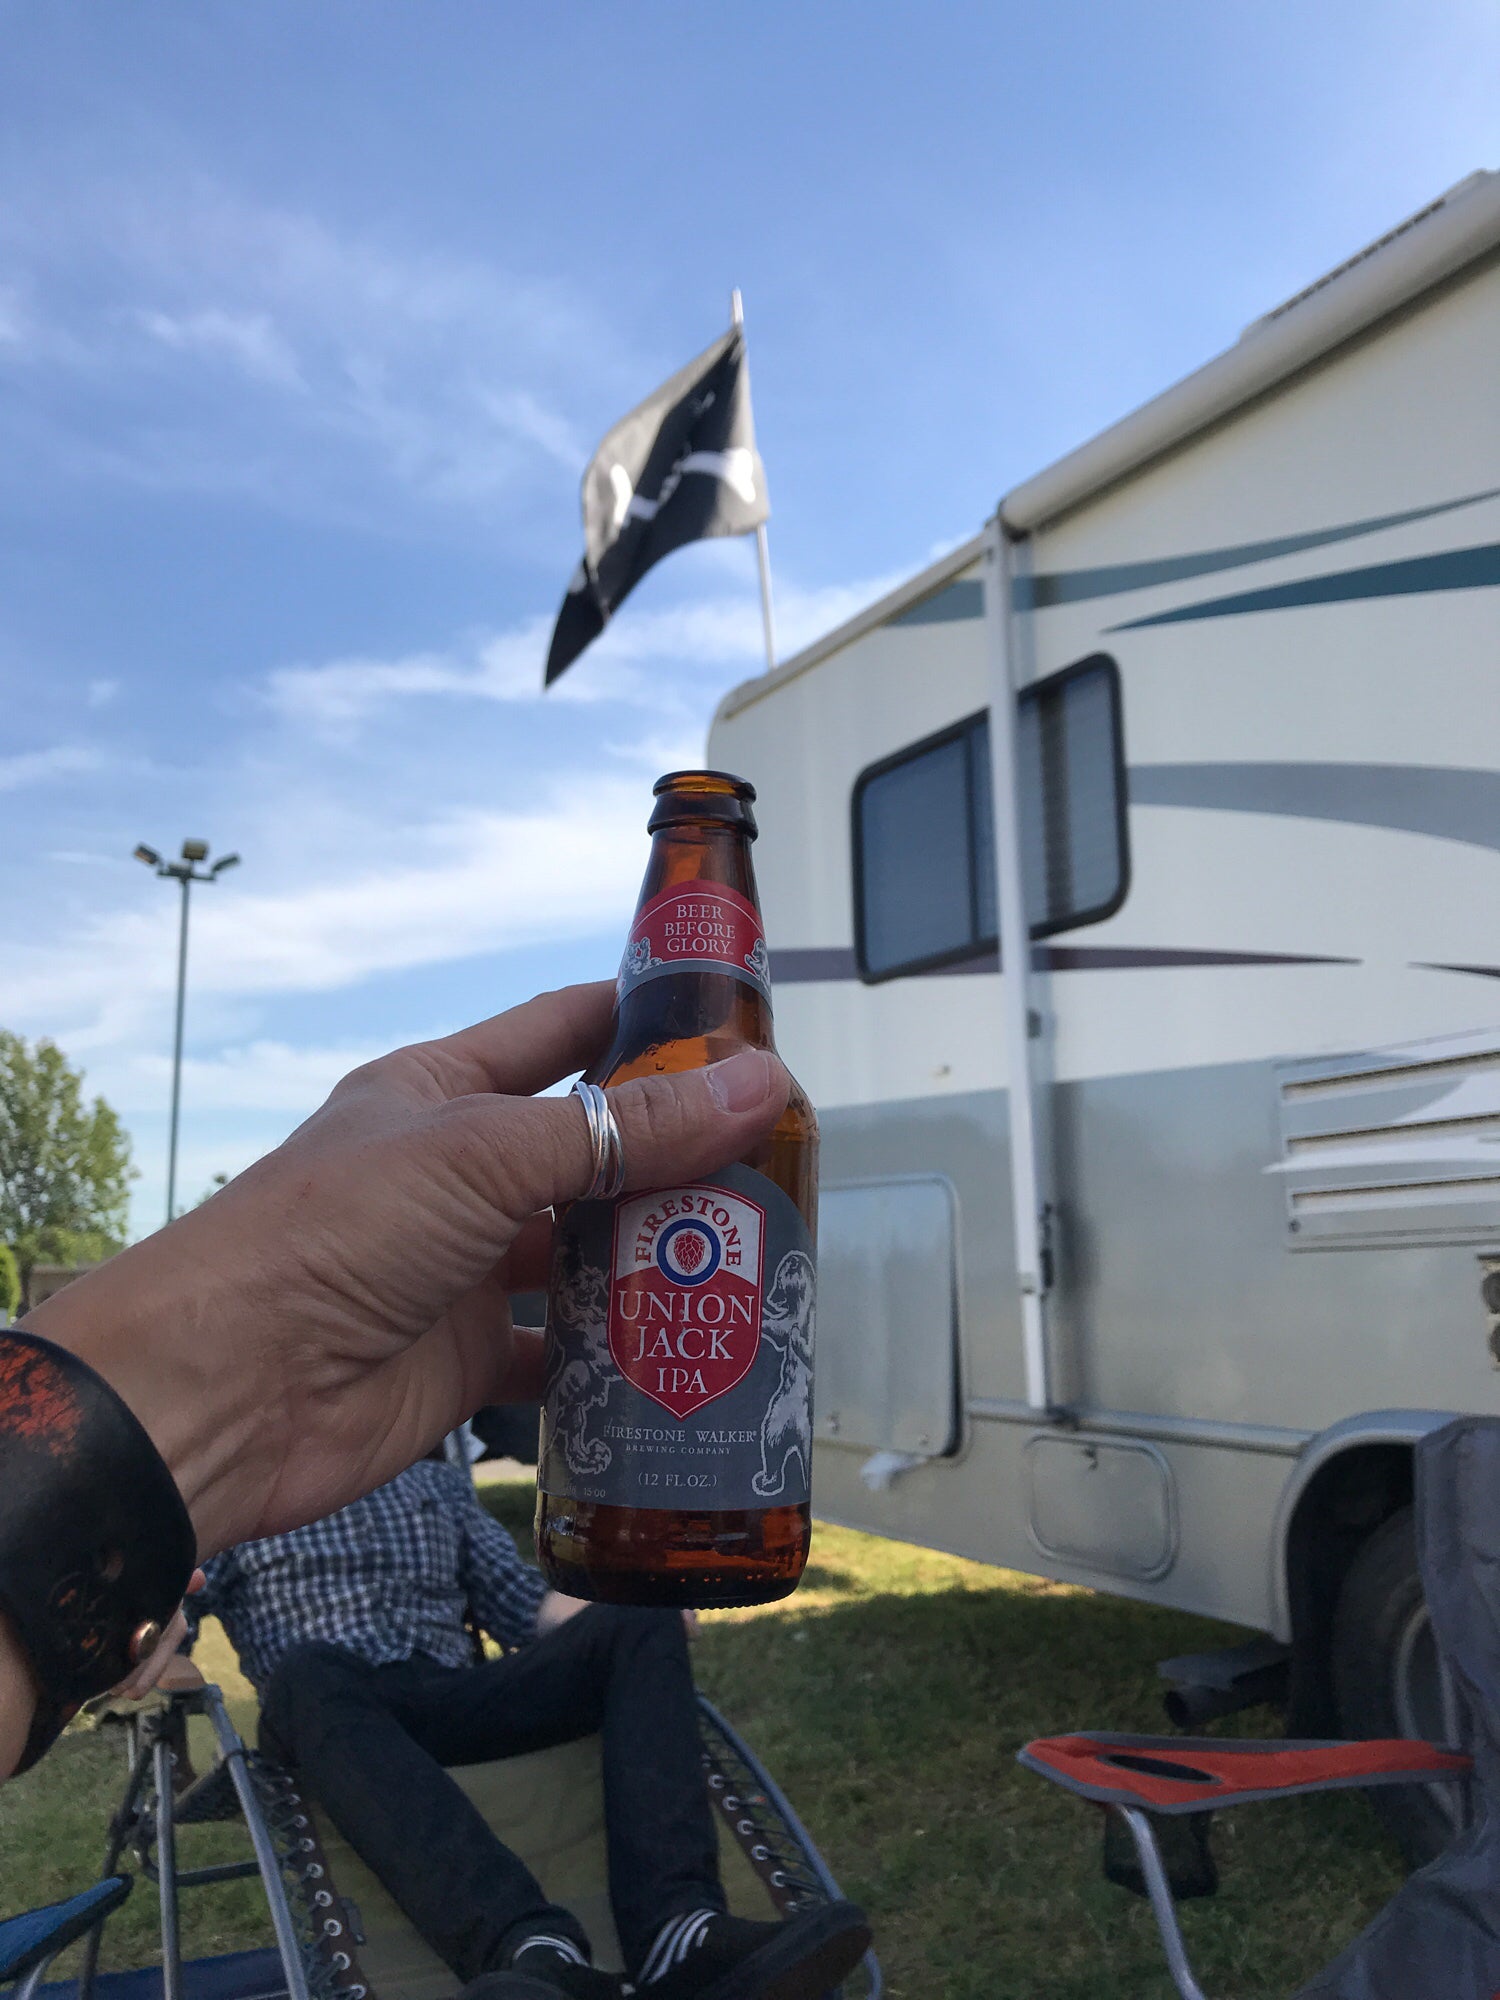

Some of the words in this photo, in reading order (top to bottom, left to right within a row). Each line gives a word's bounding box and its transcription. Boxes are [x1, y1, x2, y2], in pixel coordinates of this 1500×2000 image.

[677, 904, 723, 920] BEER
[664, 921, 735, 939] BEFORE
[667, 937, 731, 954] GLORY
[635, 1195, 742, 1267] FIRESTONE
[618, 1290, 755, 1325] UNION
[633, 1325, 734, 1361] JACK
[655, 1367, 708, 1394] IPA
[603, 1425, 686, 1442] FIRESTONE
[626, 1443, 676, 1454] BREWING
[680, 1446, 731, 1455] COMPANY
[638, 1473, 659, 1486] (12
